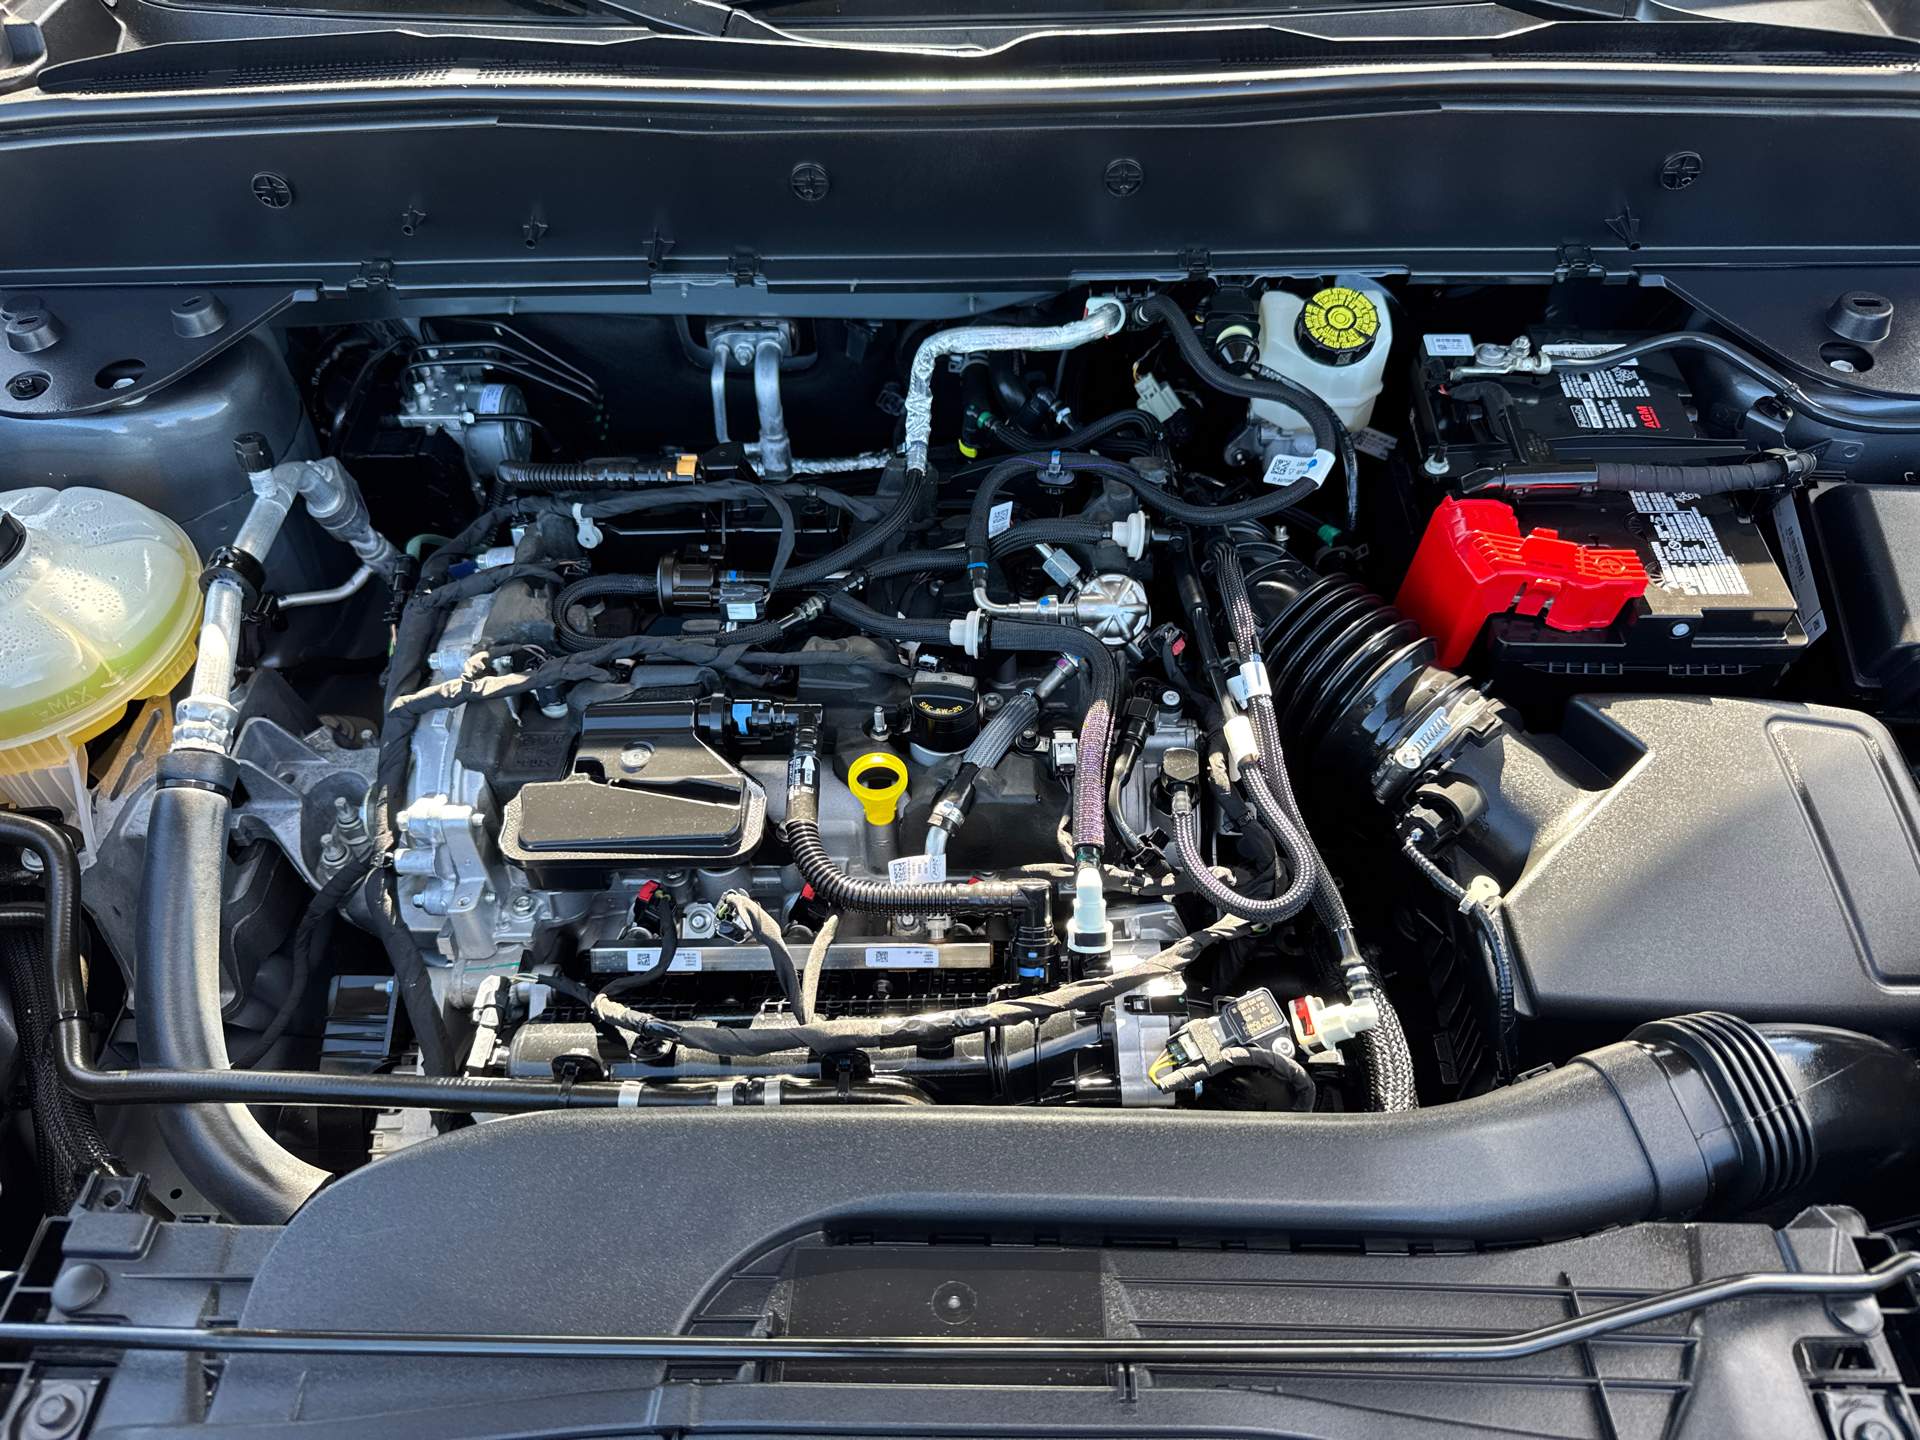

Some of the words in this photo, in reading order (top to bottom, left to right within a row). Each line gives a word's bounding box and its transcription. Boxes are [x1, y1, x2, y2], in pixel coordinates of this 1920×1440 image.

[1636, 405, 1657, 429] AGM
[47, 685, 95, 715] MAX
[919, 701, 933, 714] SAE
[935, 705, 963, 715] 5W-20
